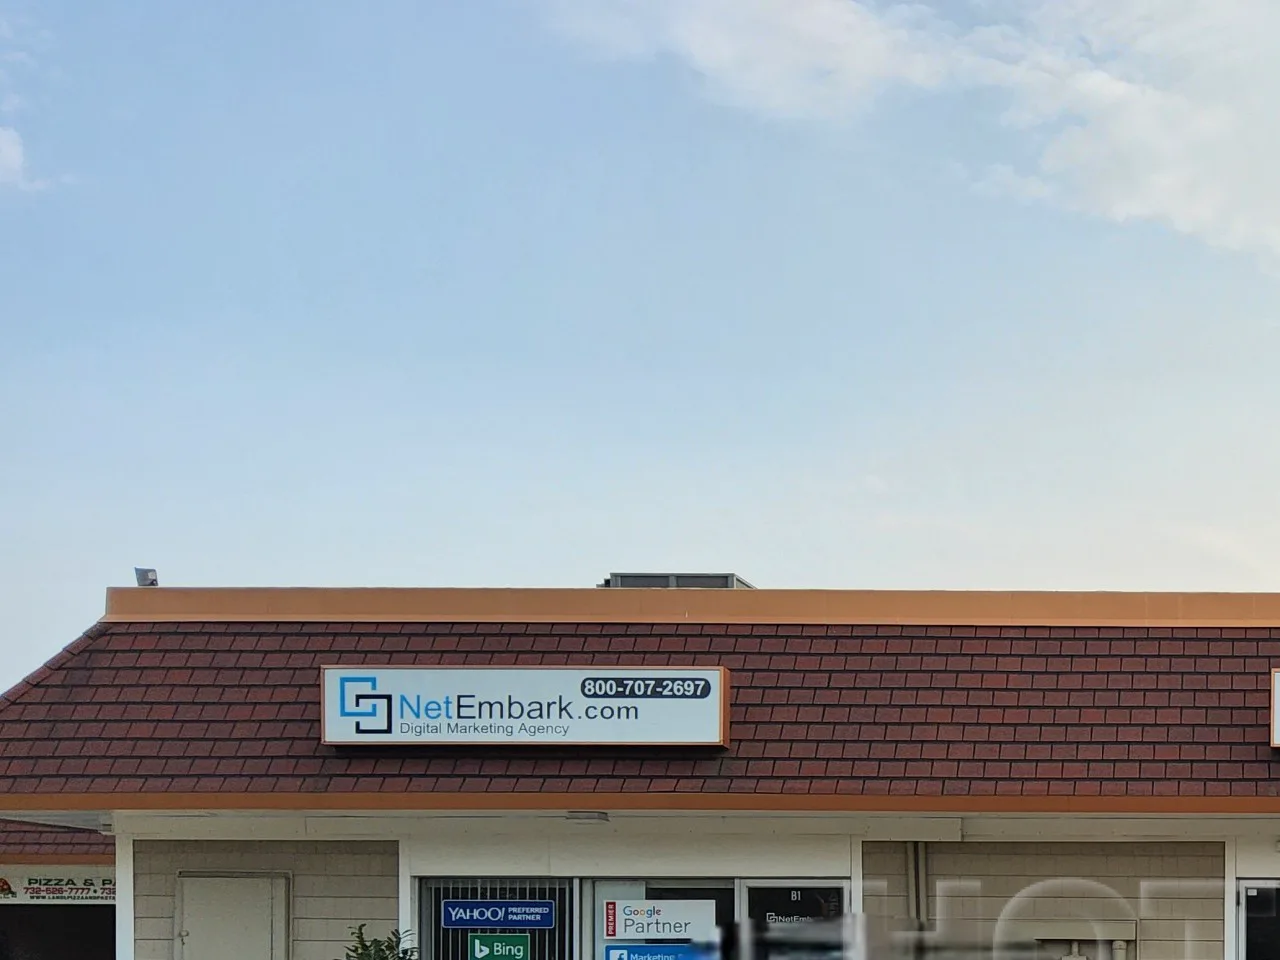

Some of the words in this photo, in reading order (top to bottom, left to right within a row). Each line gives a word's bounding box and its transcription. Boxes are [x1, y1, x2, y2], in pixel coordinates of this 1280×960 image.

[584, 679, 705, 696] 800-707-2697
[399, 694, 639, 721] NetEmbark.com
[400, 722, 442, 736] Digital
[447, 722, 514, 737] Marketing
[518, 722, 570, 737] Agency
[791, 890, 801, 901] B1
[448, 907, 505, 921] YAHOO!
[623, 905, 661, 918] Google
[624, 918, 691, 934] Partner
[493, 942, 524, 959] Bing
